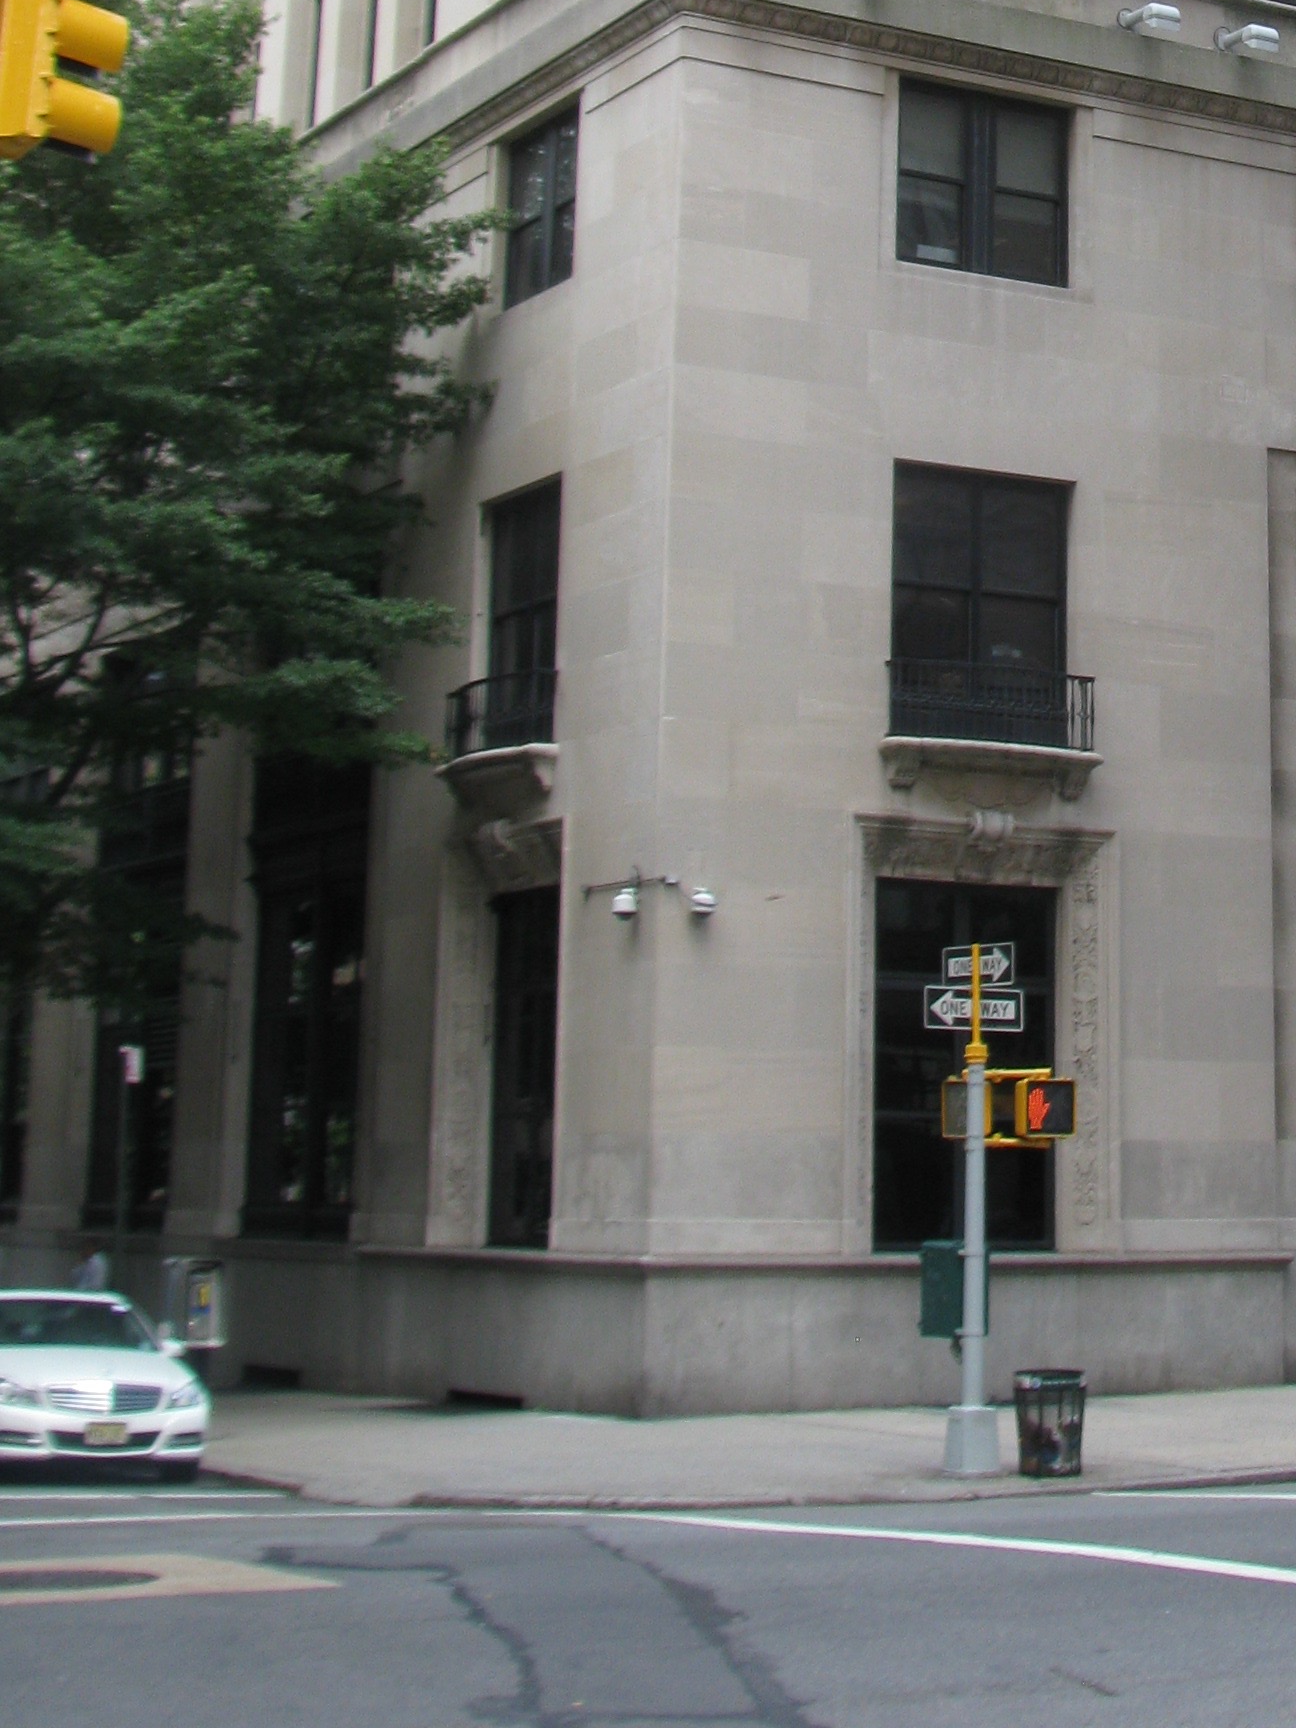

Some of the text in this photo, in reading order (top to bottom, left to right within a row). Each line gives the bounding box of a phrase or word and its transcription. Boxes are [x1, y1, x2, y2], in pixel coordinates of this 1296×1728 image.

[953, 957, 1002, 974] ONE WAY
[940, 1000, 1009, 1018] ONE WAY
